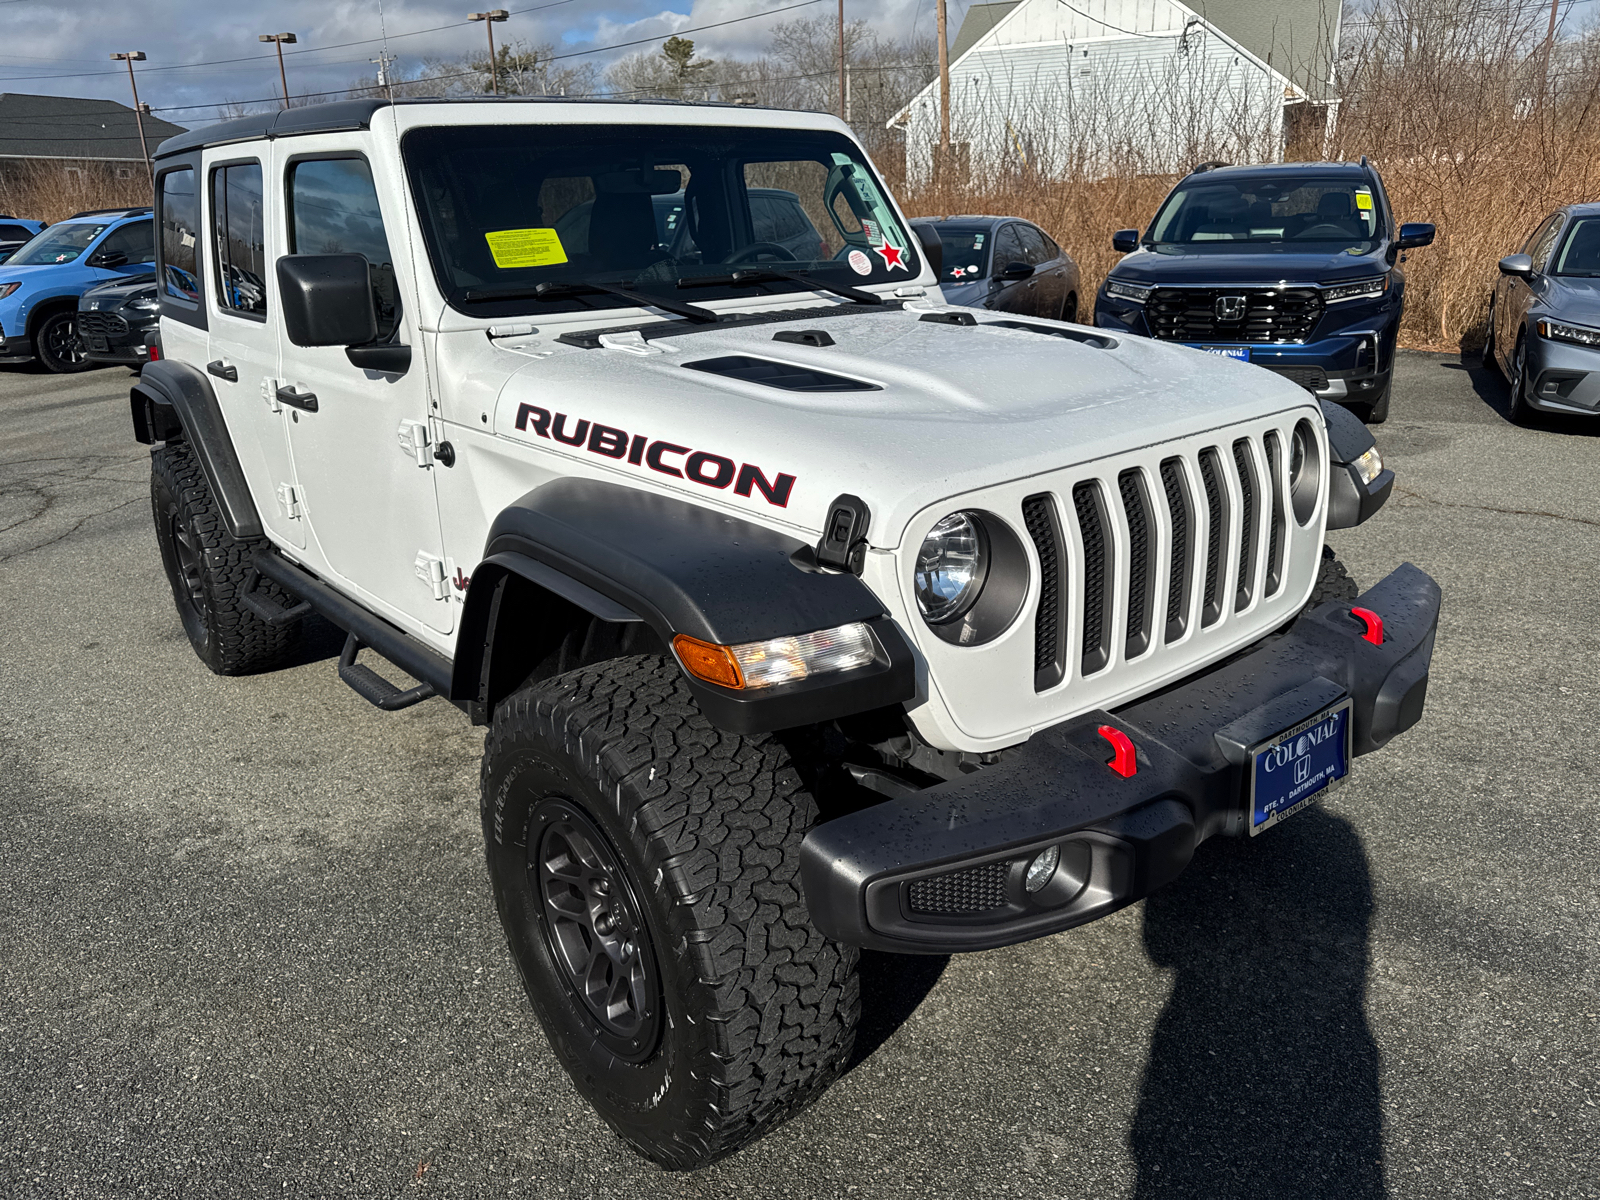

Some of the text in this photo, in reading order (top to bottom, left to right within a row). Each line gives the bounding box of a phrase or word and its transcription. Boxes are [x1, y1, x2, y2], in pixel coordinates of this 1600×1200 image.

[515, 402, 797, 508] RUBICON
[1320, 710, 1330, 720] MA
[1264, 720, 1338, 773] COLONIAL
[1263, 799, 1279, 814] RTE.
[1279, 796, 1285, 804] 6
[1325, 764, 1335, 775] MA
[1276, 786, 1330, 822] COLONIAL HONDA
